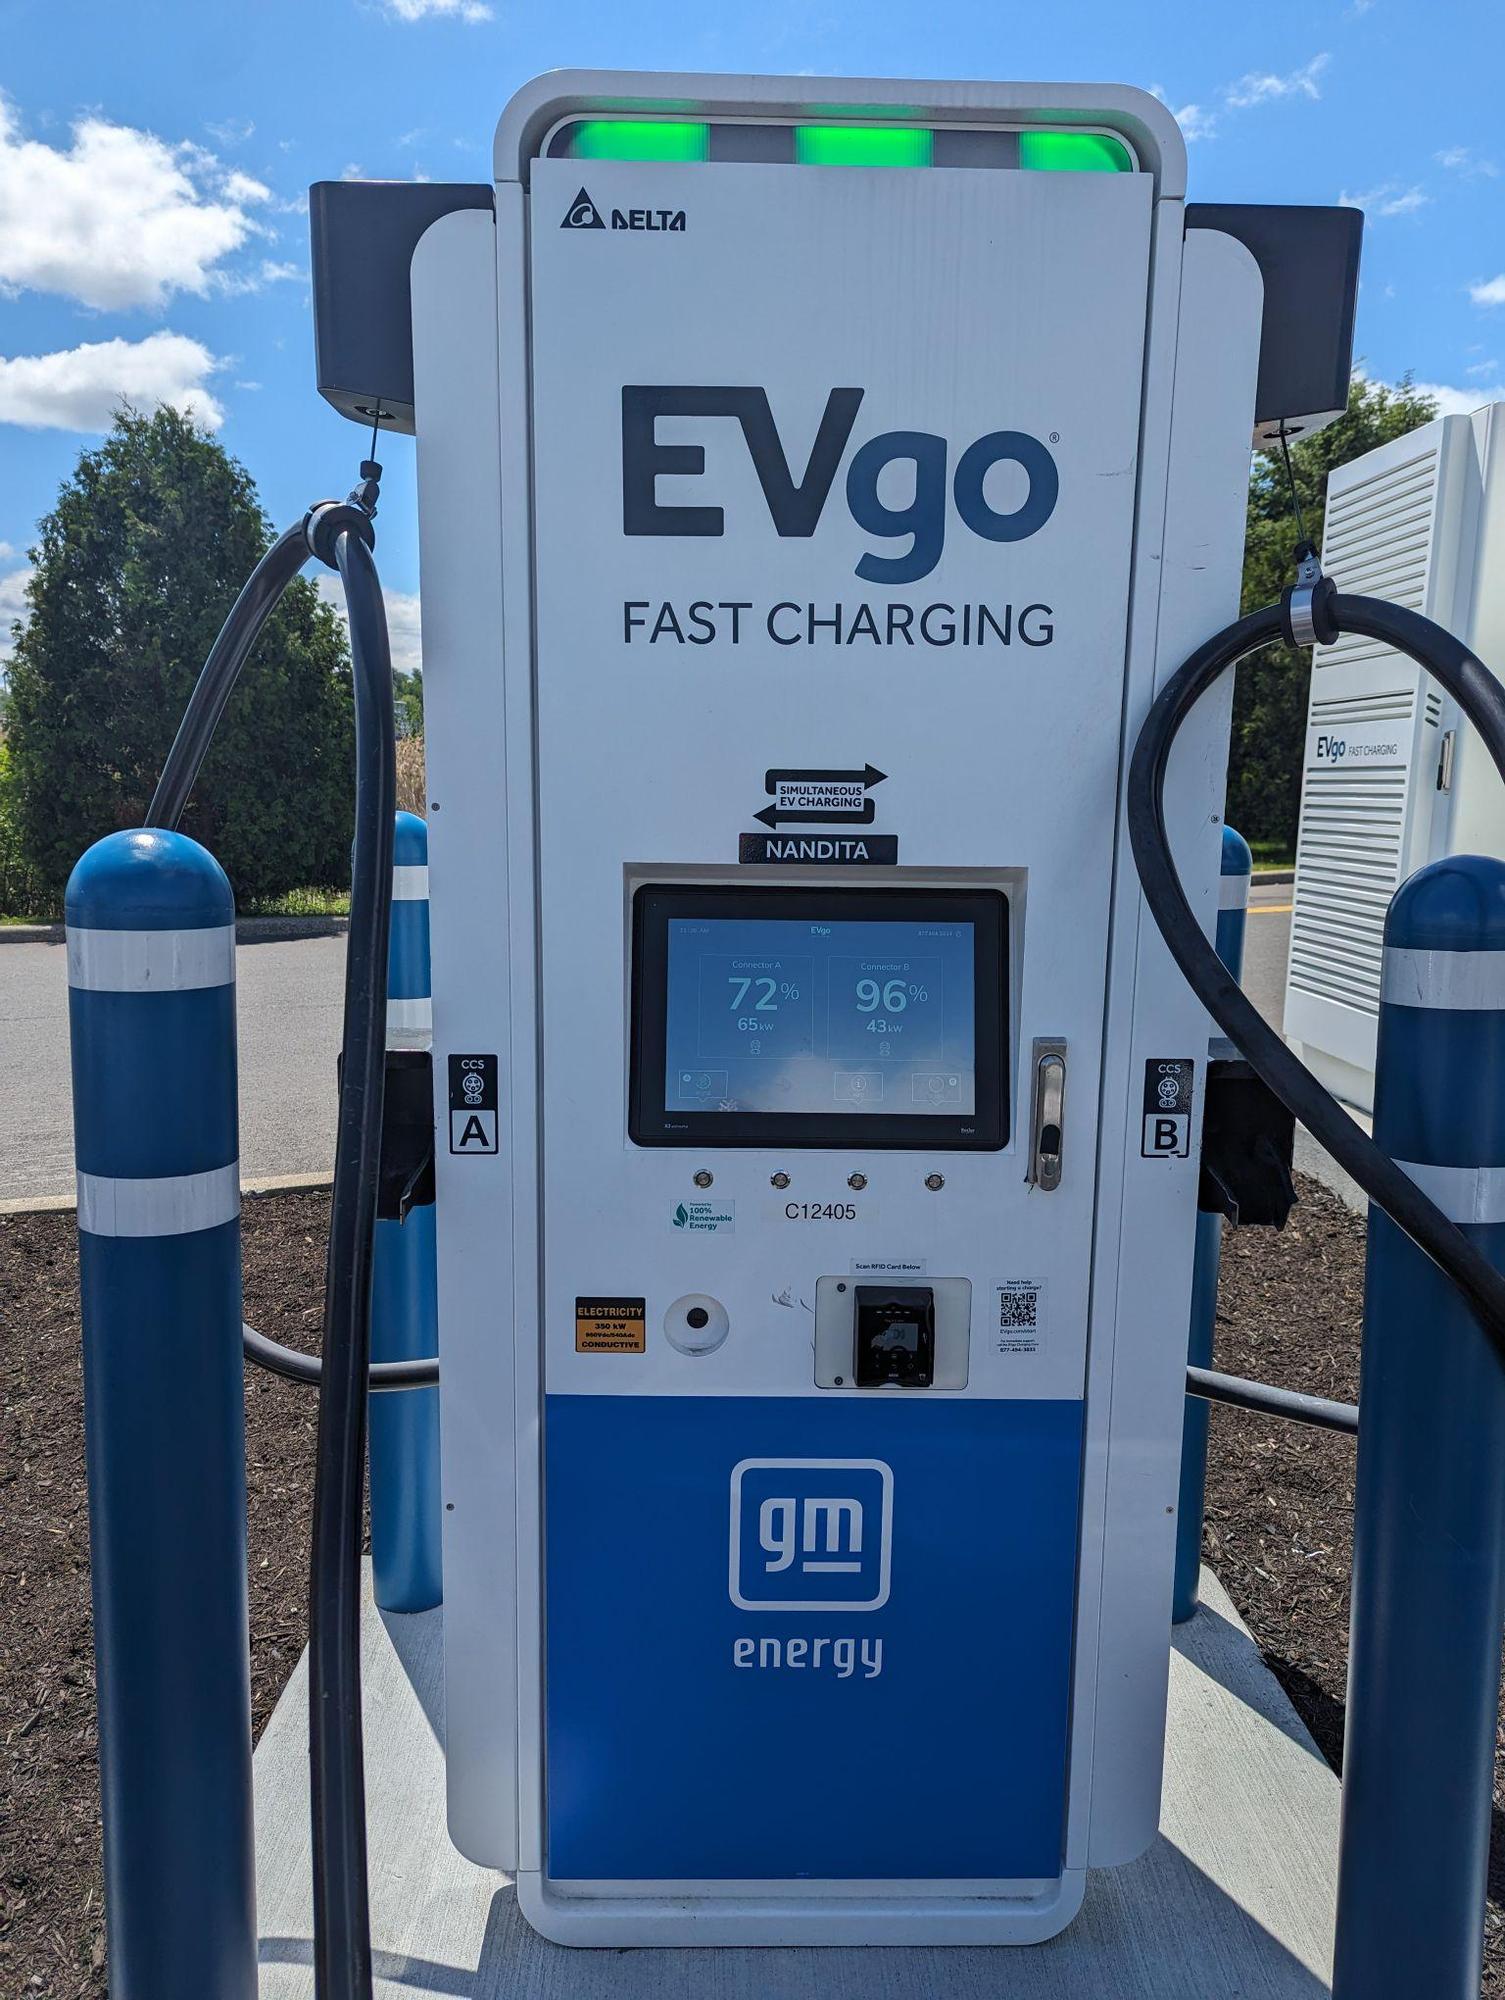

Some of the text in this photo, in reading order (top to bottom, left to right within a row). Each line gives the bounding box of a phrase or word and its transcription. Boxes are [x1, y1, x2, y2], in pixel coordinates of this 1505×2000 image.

[611, 208, 686, 231] DELTA
[622, 601, 1055, 646] FAST CHARGING
[1317, 736, 1398, 763] EVgo FAST CHARGING
[780, 785, 862, 796] SIMULTANEOUS
[780, 797, 862, 807] EV CHARGING
[766, 840, 869, 860] NANDITA
[811, 926, 831, 936] EVgo
[732, 961, 782, 969] Connector A
[860, 962, 910, 971] Connector B
[461, 1059, 485, 1070] CCS
[1158, 1064, 1181, 1074] CCS
[459, 1115, 490, 1147] A
[1154, 1119, 1178, 1150] B
[785, 1203, 856, 1220] C12405
[689, 1214, 733, 1222] Renewable
[690, 1222, 718, 1231] Energy
[577, 1307, 643, 1317] ELECTRICITY
[759, 1497, 863, 1573] gm
[733, 1638, 883, 1678] energy
